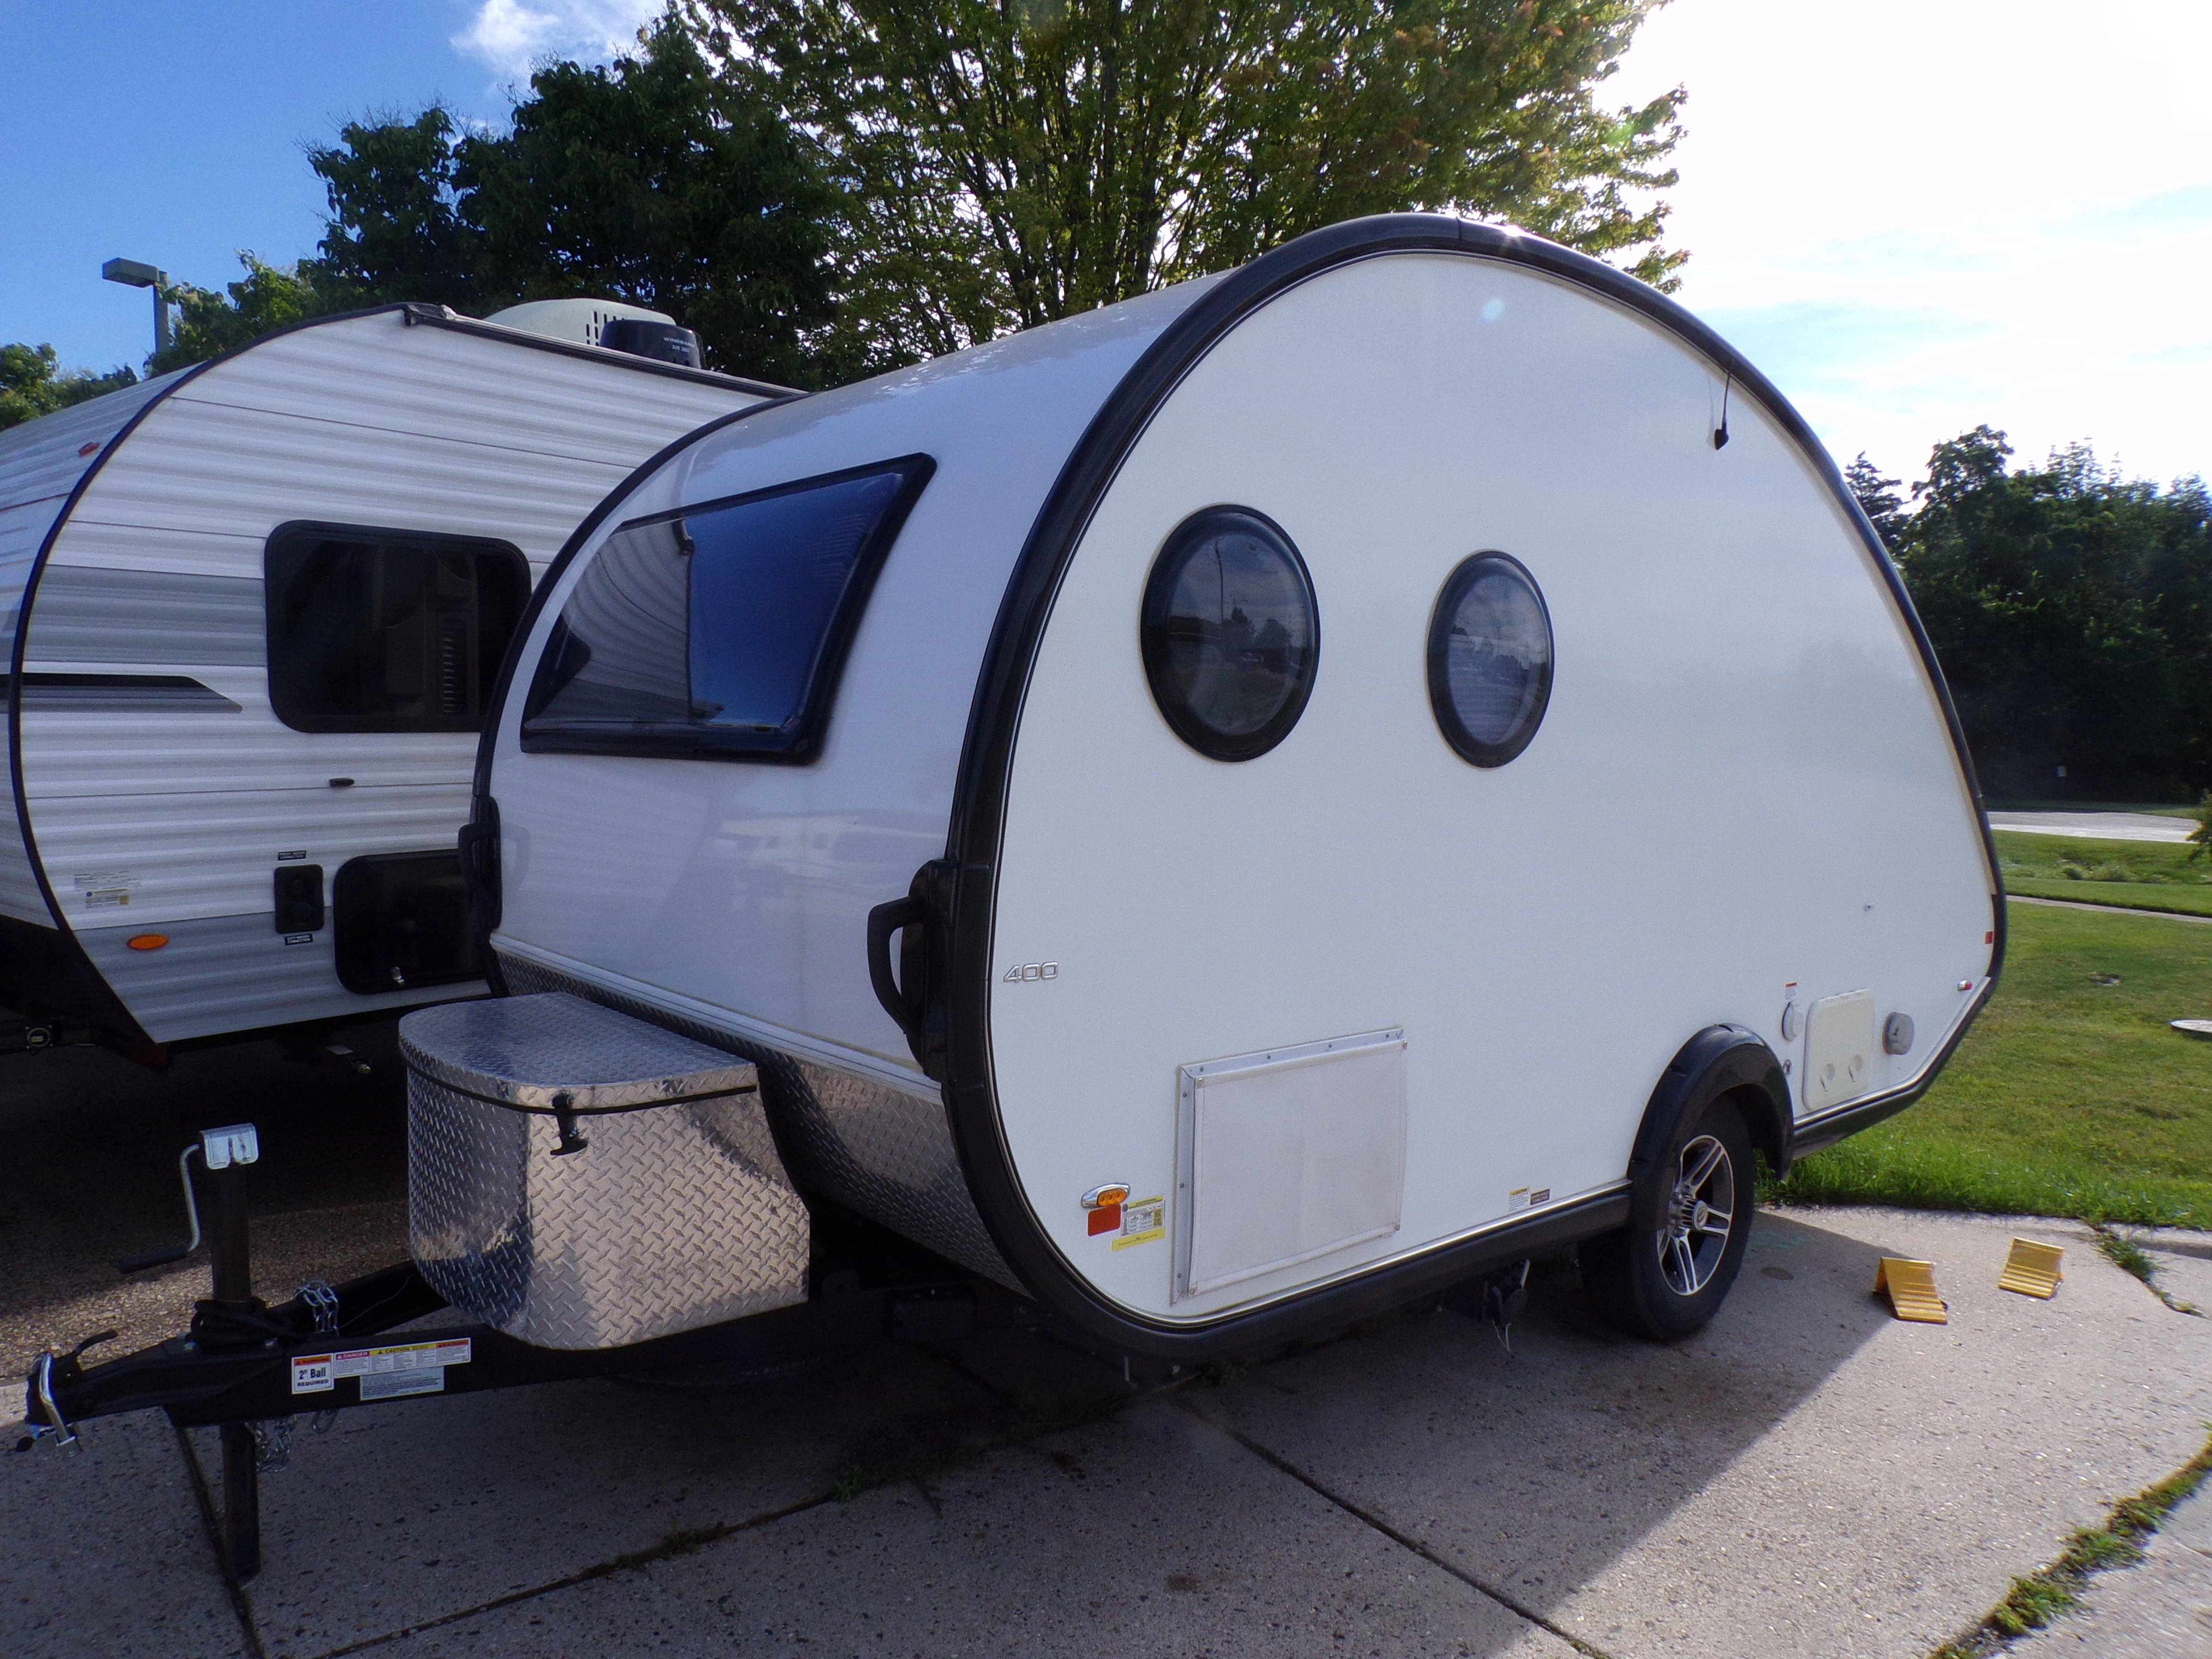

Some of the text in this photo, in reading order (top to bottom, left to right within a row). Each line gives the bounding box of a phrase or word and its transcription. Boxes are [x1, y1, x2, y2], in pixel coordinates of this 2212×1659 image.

[1003, 961, 1058, 983] 400
[310, 1367, 326, 1378] Ball
[297, 1379, 329, 1387] REQUIRED
